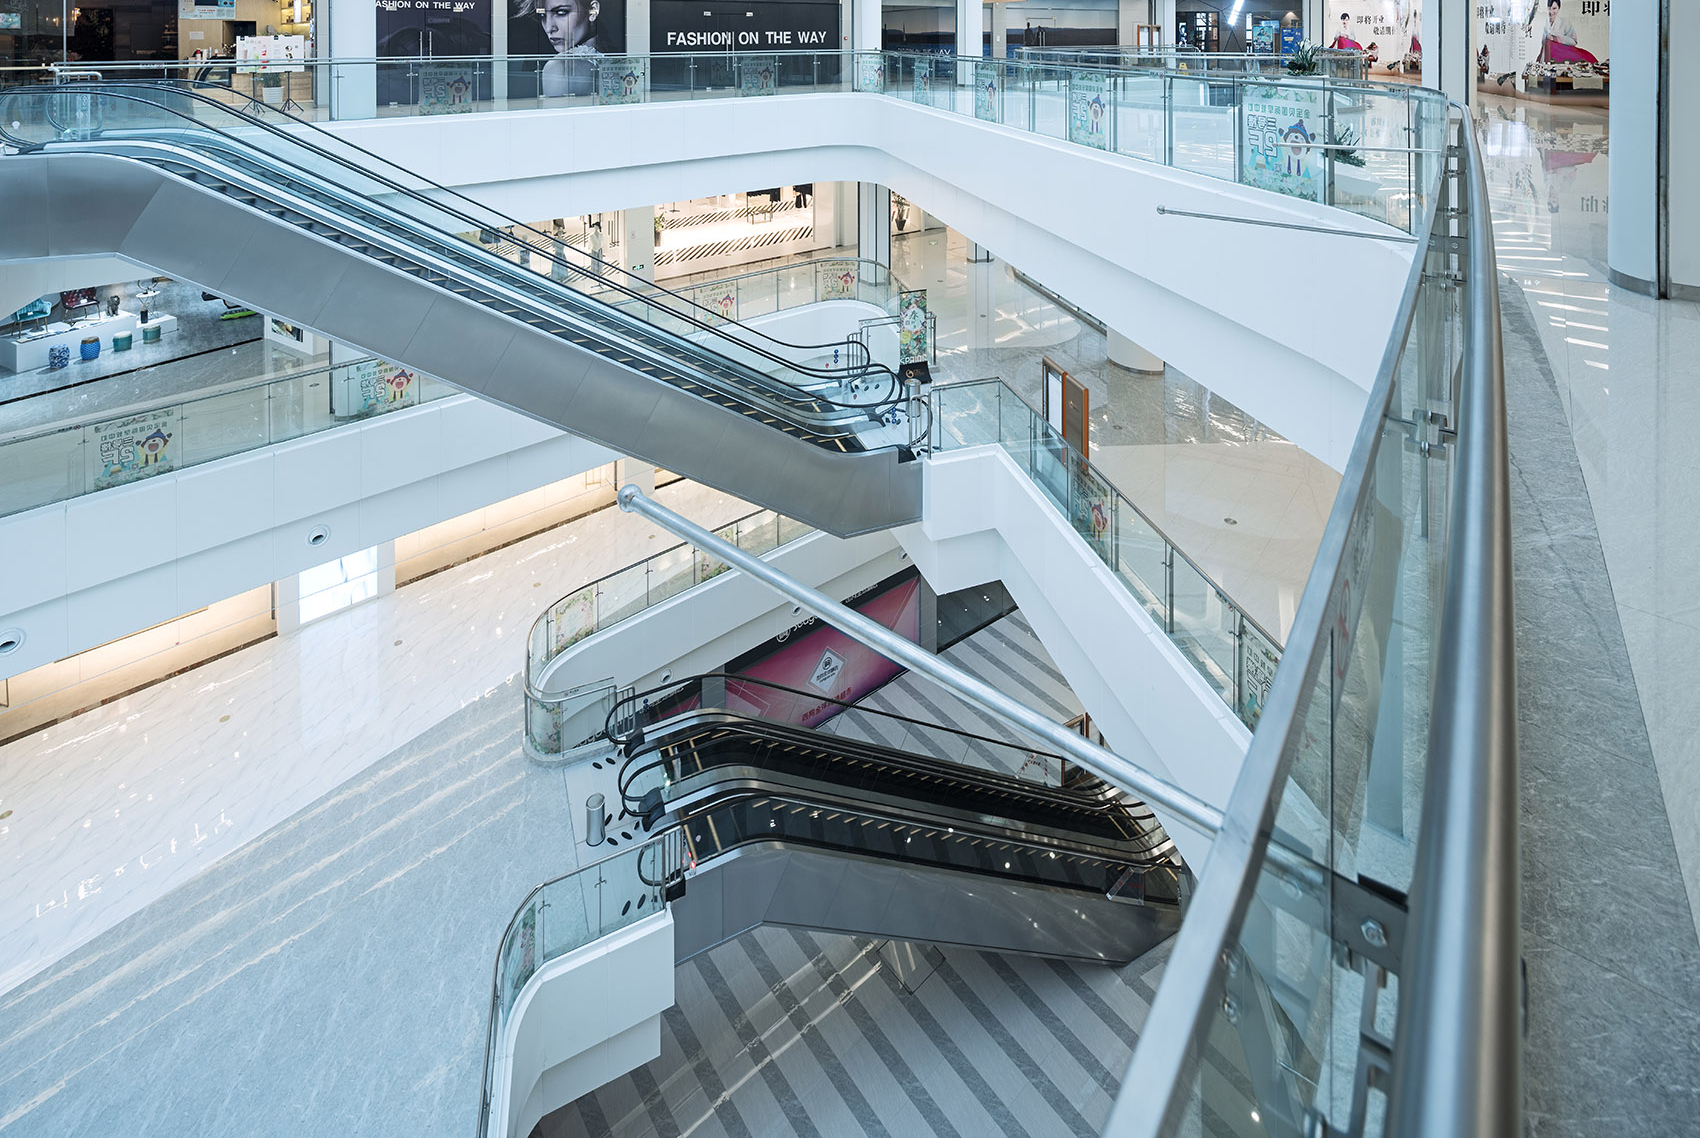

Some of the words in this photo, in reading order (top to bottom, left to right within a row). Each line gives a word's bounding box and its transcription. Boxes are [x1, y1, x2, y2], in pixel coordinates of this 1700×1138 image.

[415, 1, 429, 9] ON
[433, 1, 451, 9] THE
[454, 2, 475, 10] WAY
[667, 31, 731, 46] FASHION
[738, 31, 759, 45] ON
[765, 31, 791, 44] THE
[797, 31, 827, 44] WAY
